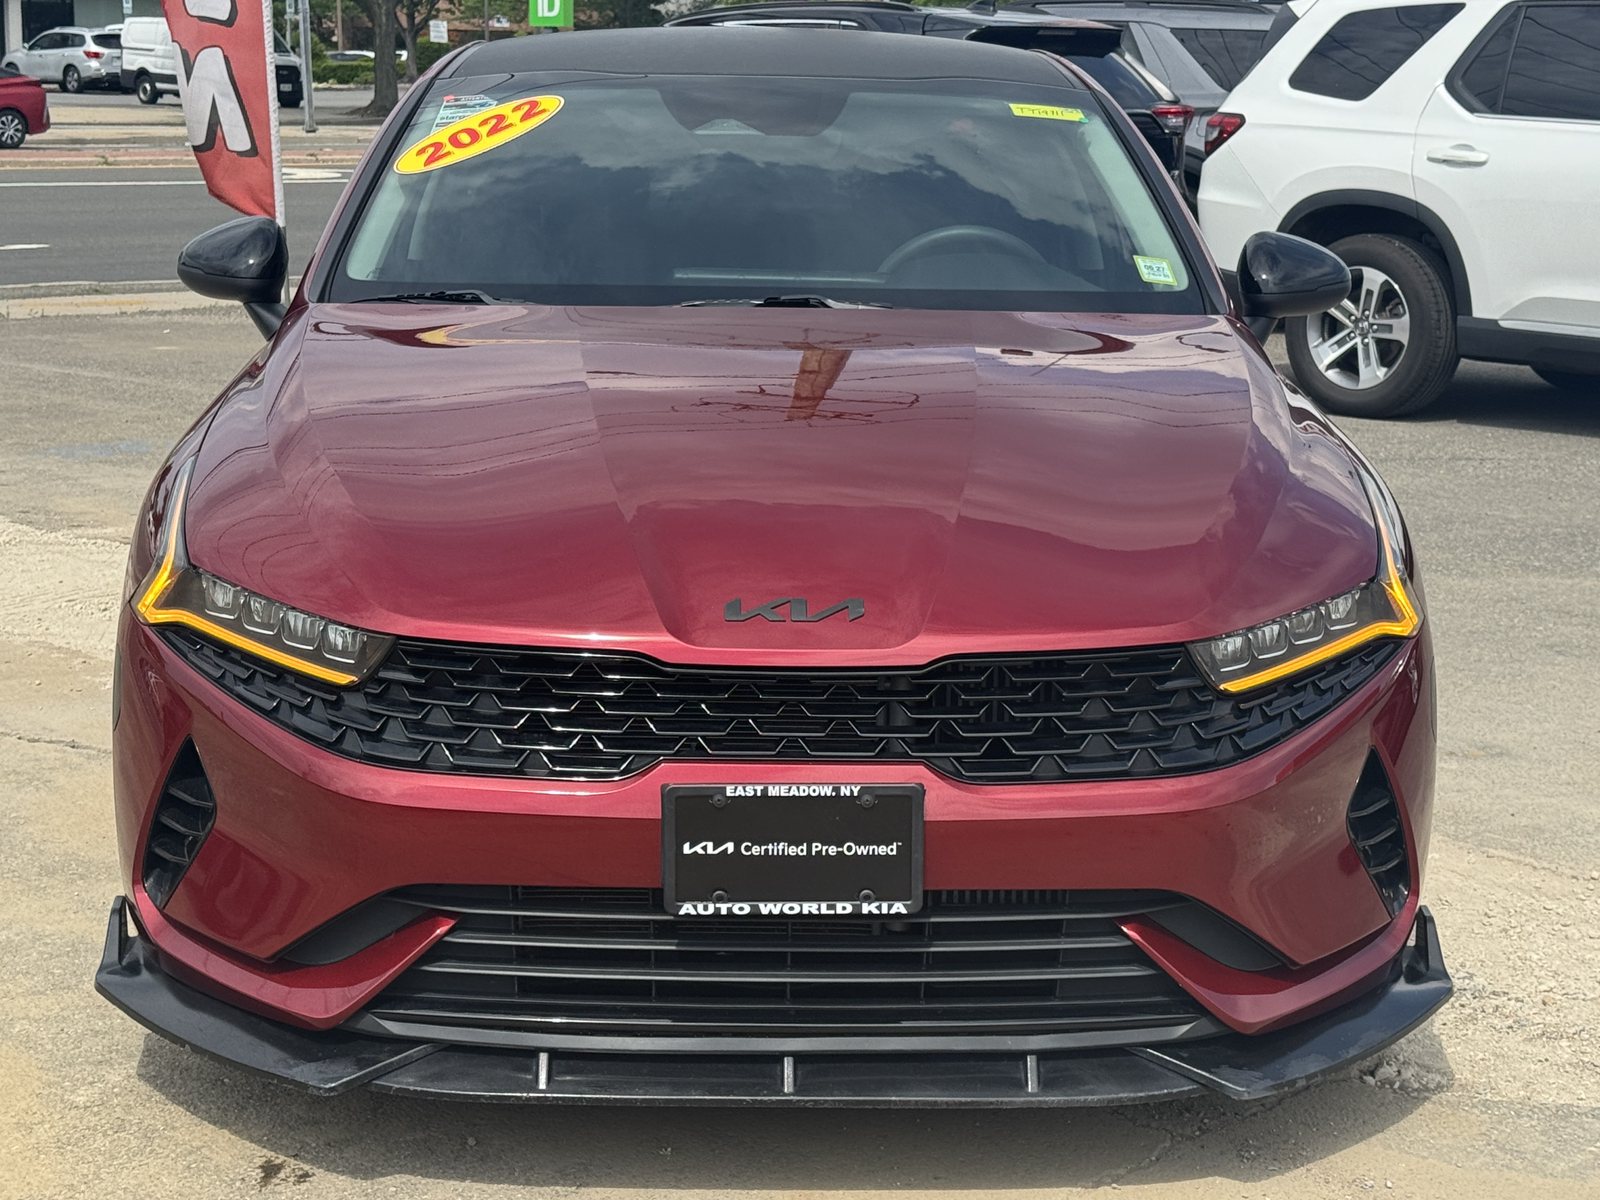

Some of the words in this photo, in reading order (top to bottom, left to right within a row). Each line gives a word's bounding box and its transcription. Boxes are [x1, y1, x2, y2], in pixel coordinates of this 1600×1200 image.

[415, 99, 550, 167] 2022
[724, 597, 865, 622] KIA
[725, 785, 764, 797] EAST
[840, 785, 861, 797] NY
[682, 841, 735, 855] KIA
[740, 841, 807, 856] Certified
[678, 902, 751, 915] AUTO
[758, 902, 853, 915] WORLD
[861, 902, 908, 915] KIA
